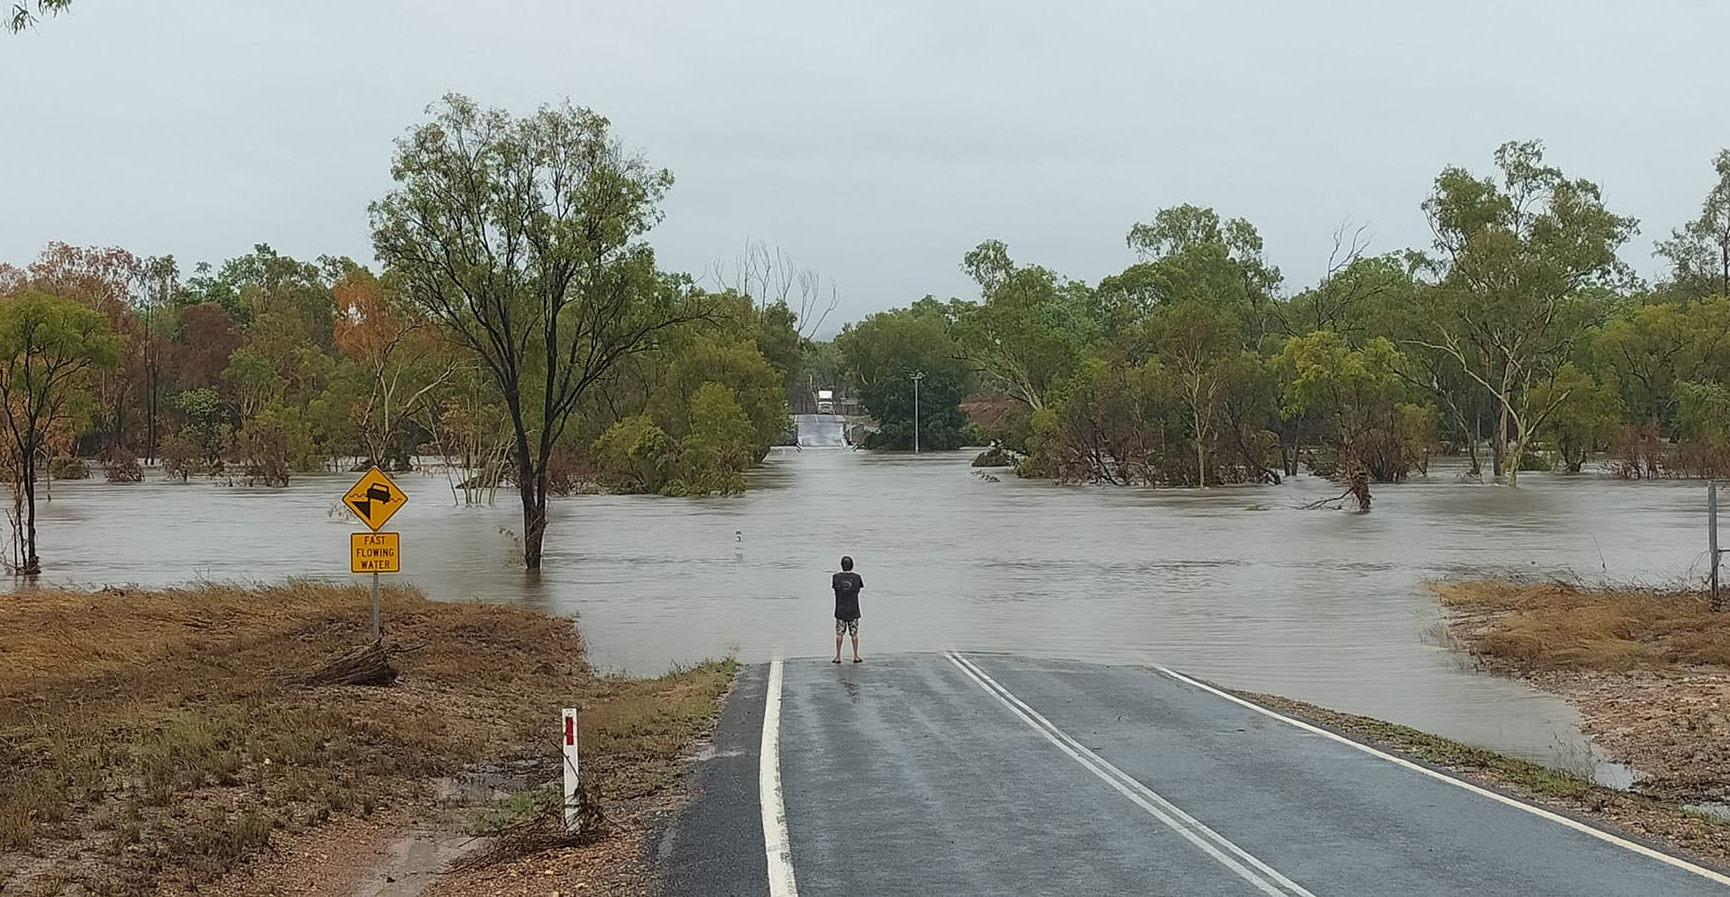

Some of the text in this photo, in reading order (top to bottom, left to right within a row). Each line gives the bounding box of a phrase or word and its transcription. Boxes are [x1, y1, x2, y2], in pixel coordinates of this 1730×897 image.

[364, 536, 386, 545] FAST
[356, 548, 394, 558] FLOWING
[361, 560, 390, 570] WATER
